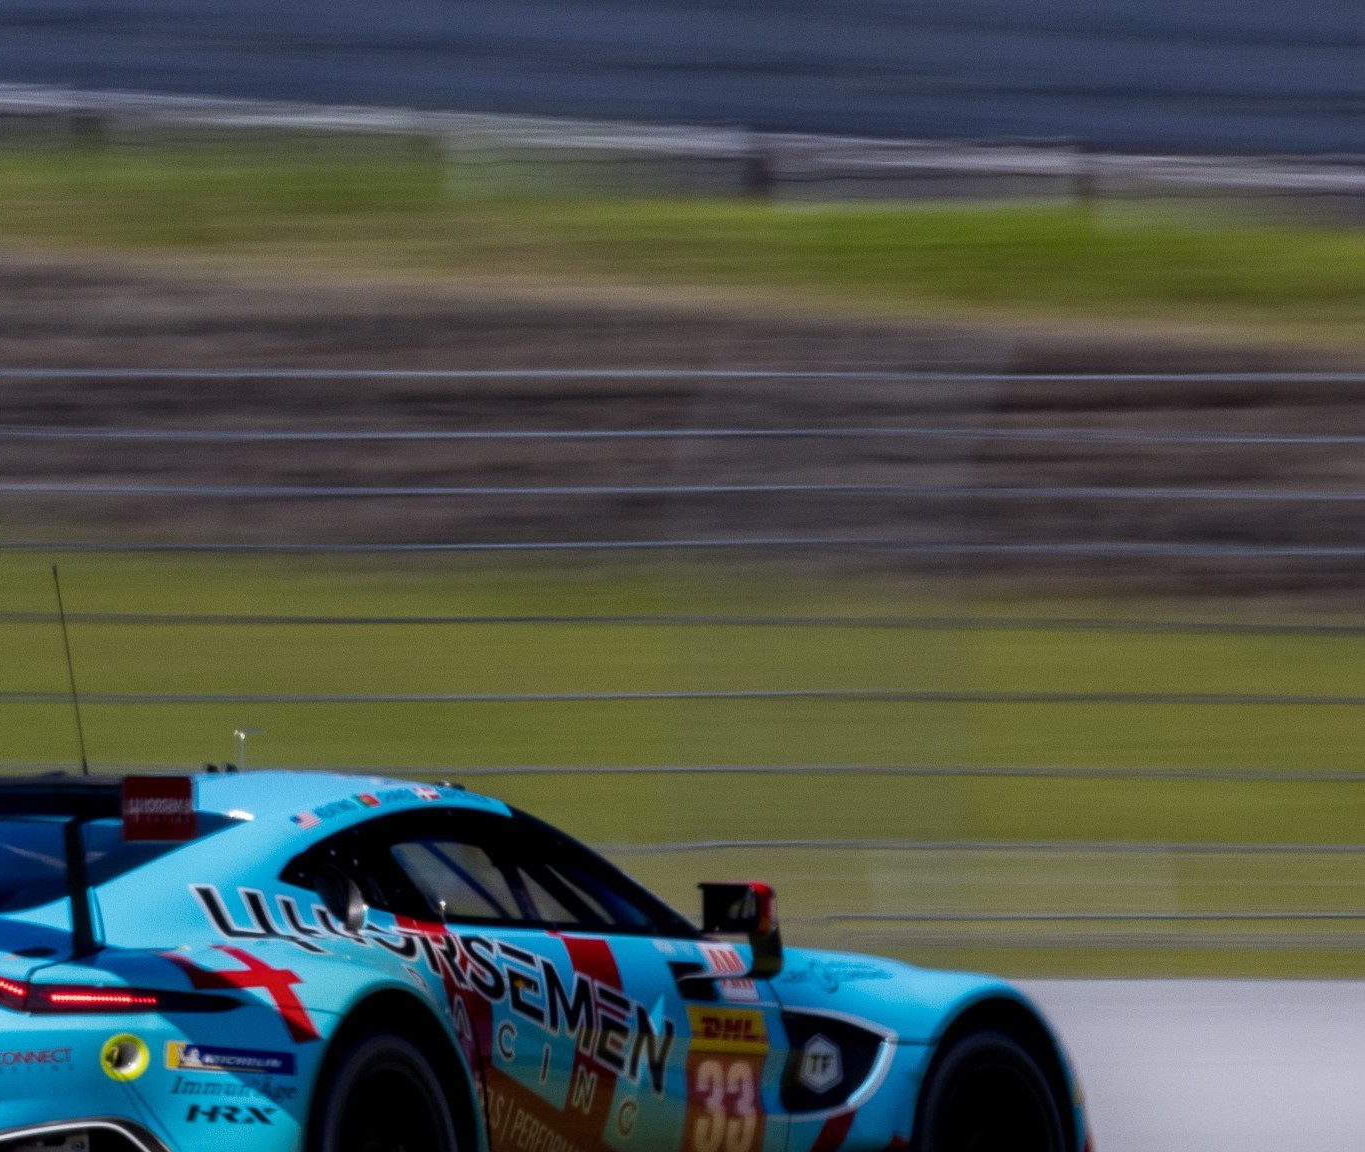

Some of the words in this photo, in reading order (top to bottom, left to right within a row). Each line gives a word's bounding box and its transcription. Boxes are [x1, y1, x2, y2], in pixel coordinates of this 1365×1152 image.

[701, 1016, 757, 1041] DHL
[810, 1054, 831, 1075] TF
[185, 1104, 280, 1125] HRX
